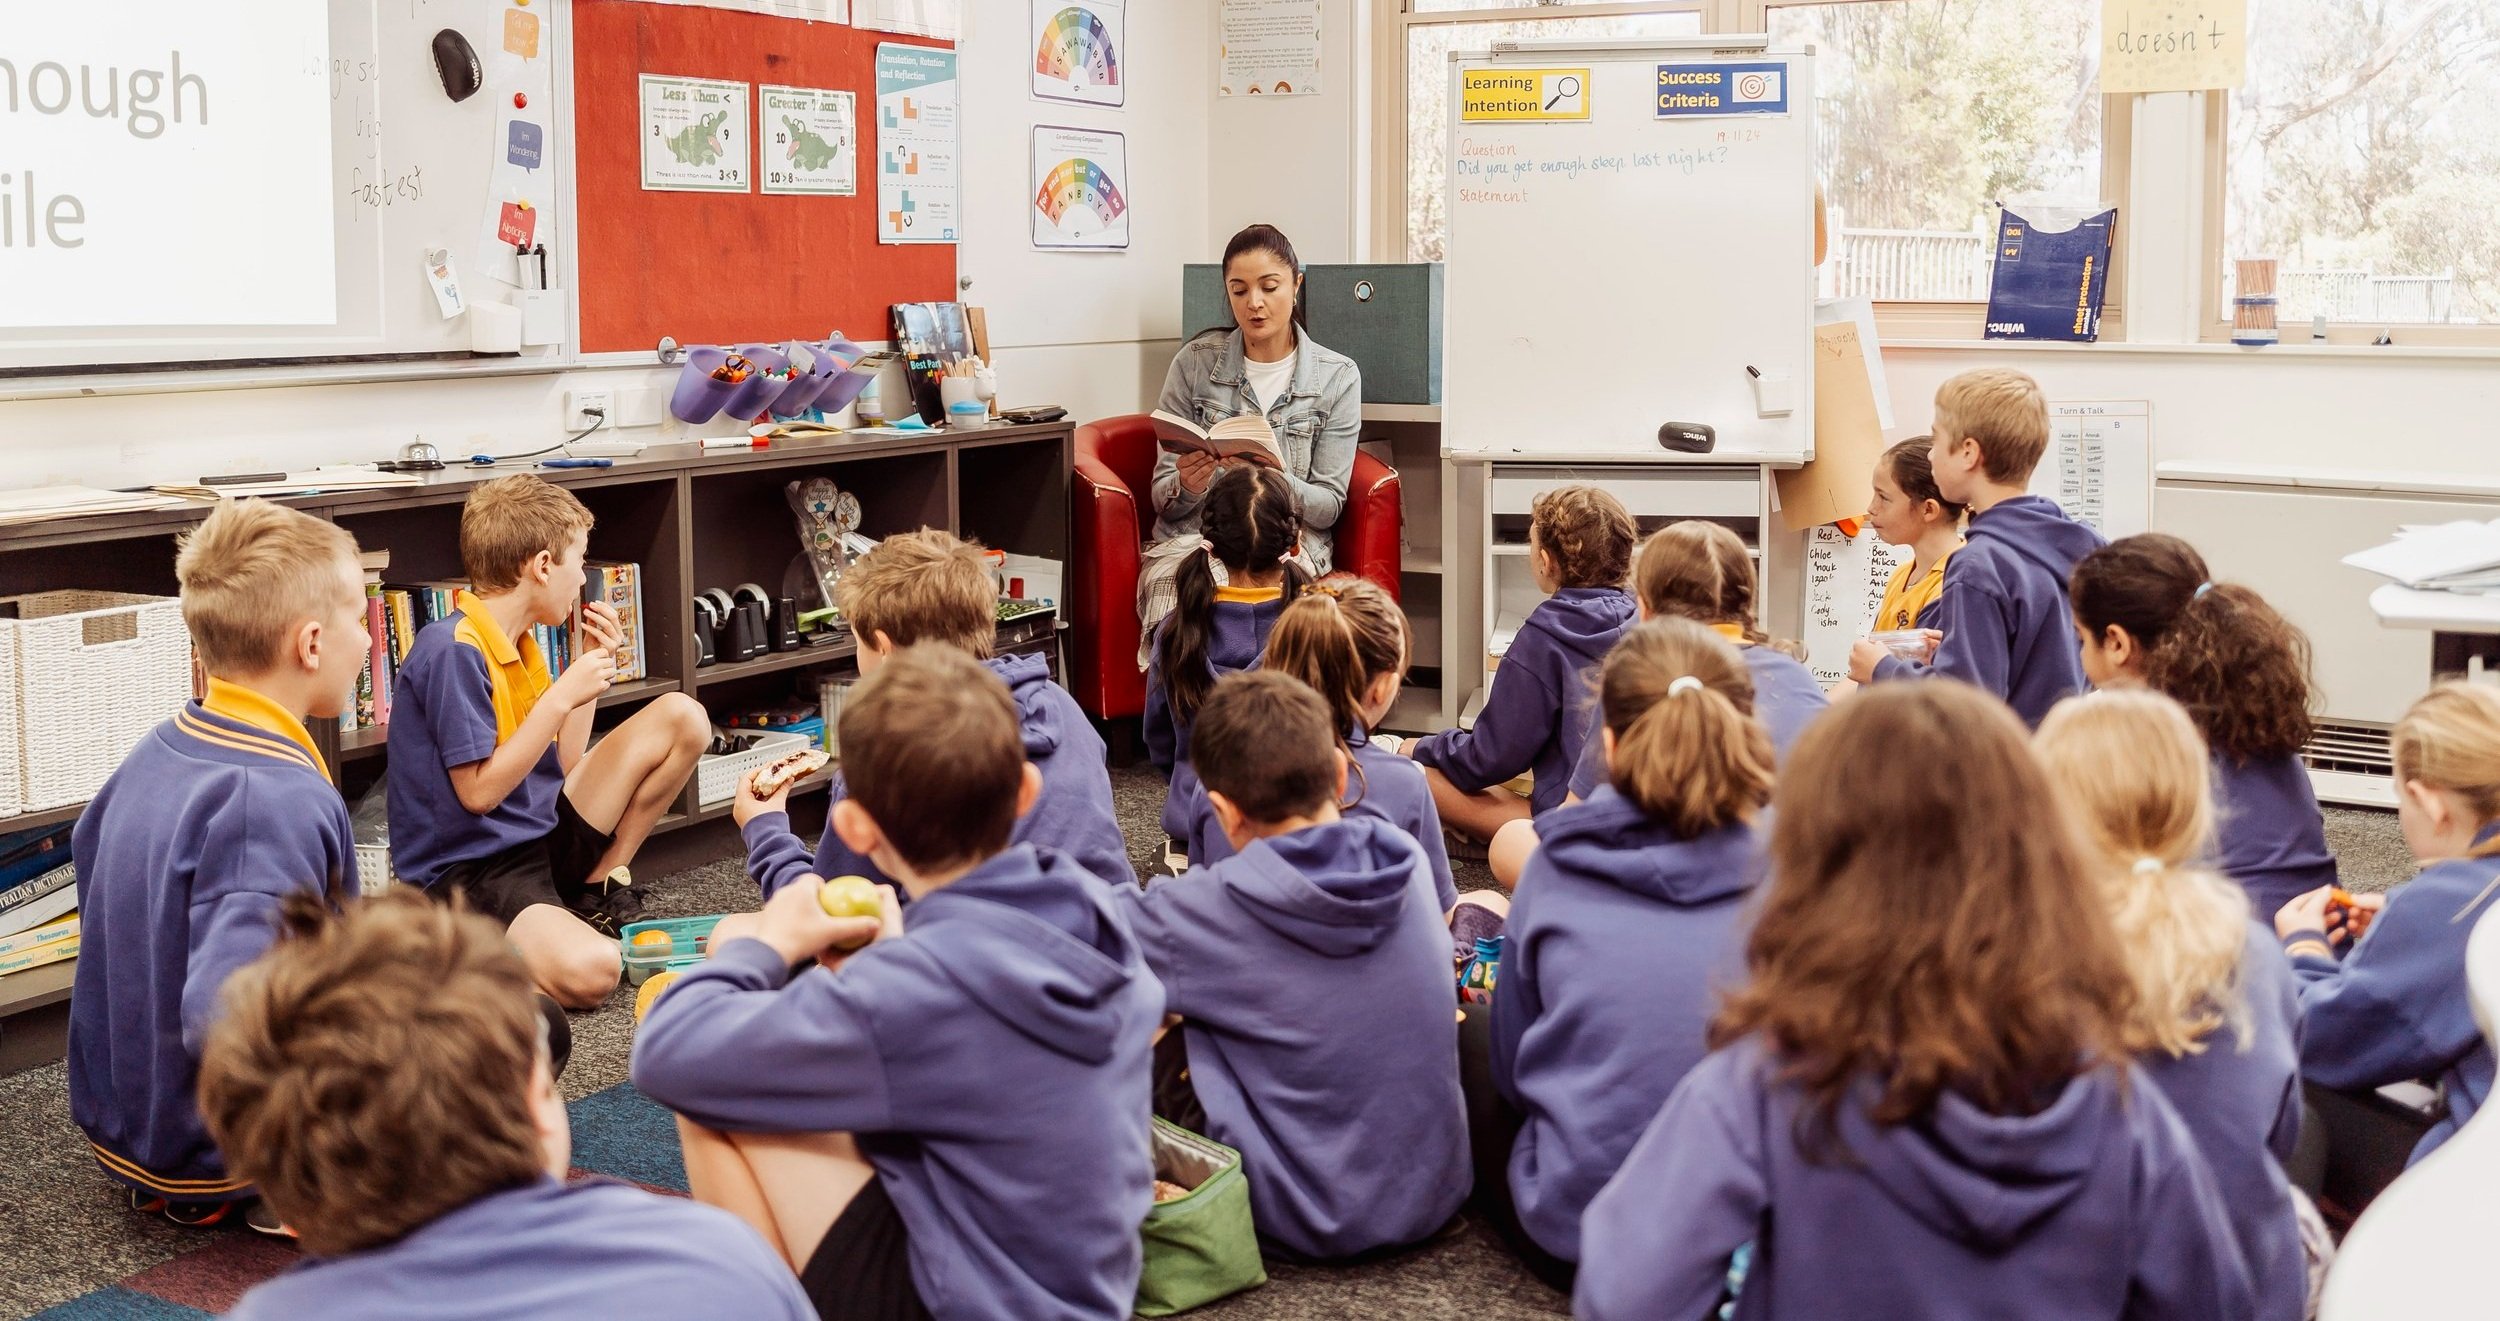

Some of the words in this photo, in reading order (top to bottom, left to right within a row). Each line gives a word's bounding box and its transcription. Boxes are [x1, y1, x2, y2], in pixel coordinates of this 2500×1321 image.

[2117, 10, 2226, 54] doesn't
[880, 53, 919, 66] Translation,
[920, 57, 946, 68] Rotation
[880, 69, 894, 79] and
[895, 70, 926, 82] Reflection
[1658, 70, 1722, 85] Success
[1465, 75, 1533, 92] Learning
[662, 86, 688, 101] Less
[691, 89, 720, 105] Than
[1658, 91, 1720, 108] Criteria
[768, 96, 808, 111] Greater
[1465, 98, 1538, 112] Intention
[654, 124, 660, 137] 3
[723, 128, 730, 141] 9
[776, 132, 786, 145] 10
[1461, 137, 1517, 157] Question
[1074, 163, 1087, 174] but
[1457, 158, 1480, 175] Did
[1485, 161, 1509, 185] you
[1513, 158, 1533, 183] get
[1540, 154, 1588, 180] enough
[1633, 151, 1661, 167] last
[1667, 145, 1728, 176] night?
[351, 165, 424, 223] fastest
[1459, 187, 1529, 204] Statement
[0, 170, 86, 249] ile
[2006, 228, 2022, 236] 100
[2079, 255, 2094, 308] protectors
[2073, 307, 2086, 335] sheet
[910, 360, 927, 370] Best
[2059, 407, 2078, 415] Turn
[2088, 407, 2104, 415] Talk
[2114, 421, 2121, 429] B
[1817, 528, 1833, 540] Red
[1809, 548, 1832, 560] Chloe
[1872, 545, 1888, 556] Ben
[362, 650, 372, 694] COLLECTED
[1811, 666, 1841, 679] Green
[36, 927, 70, 943] Thesaurus
